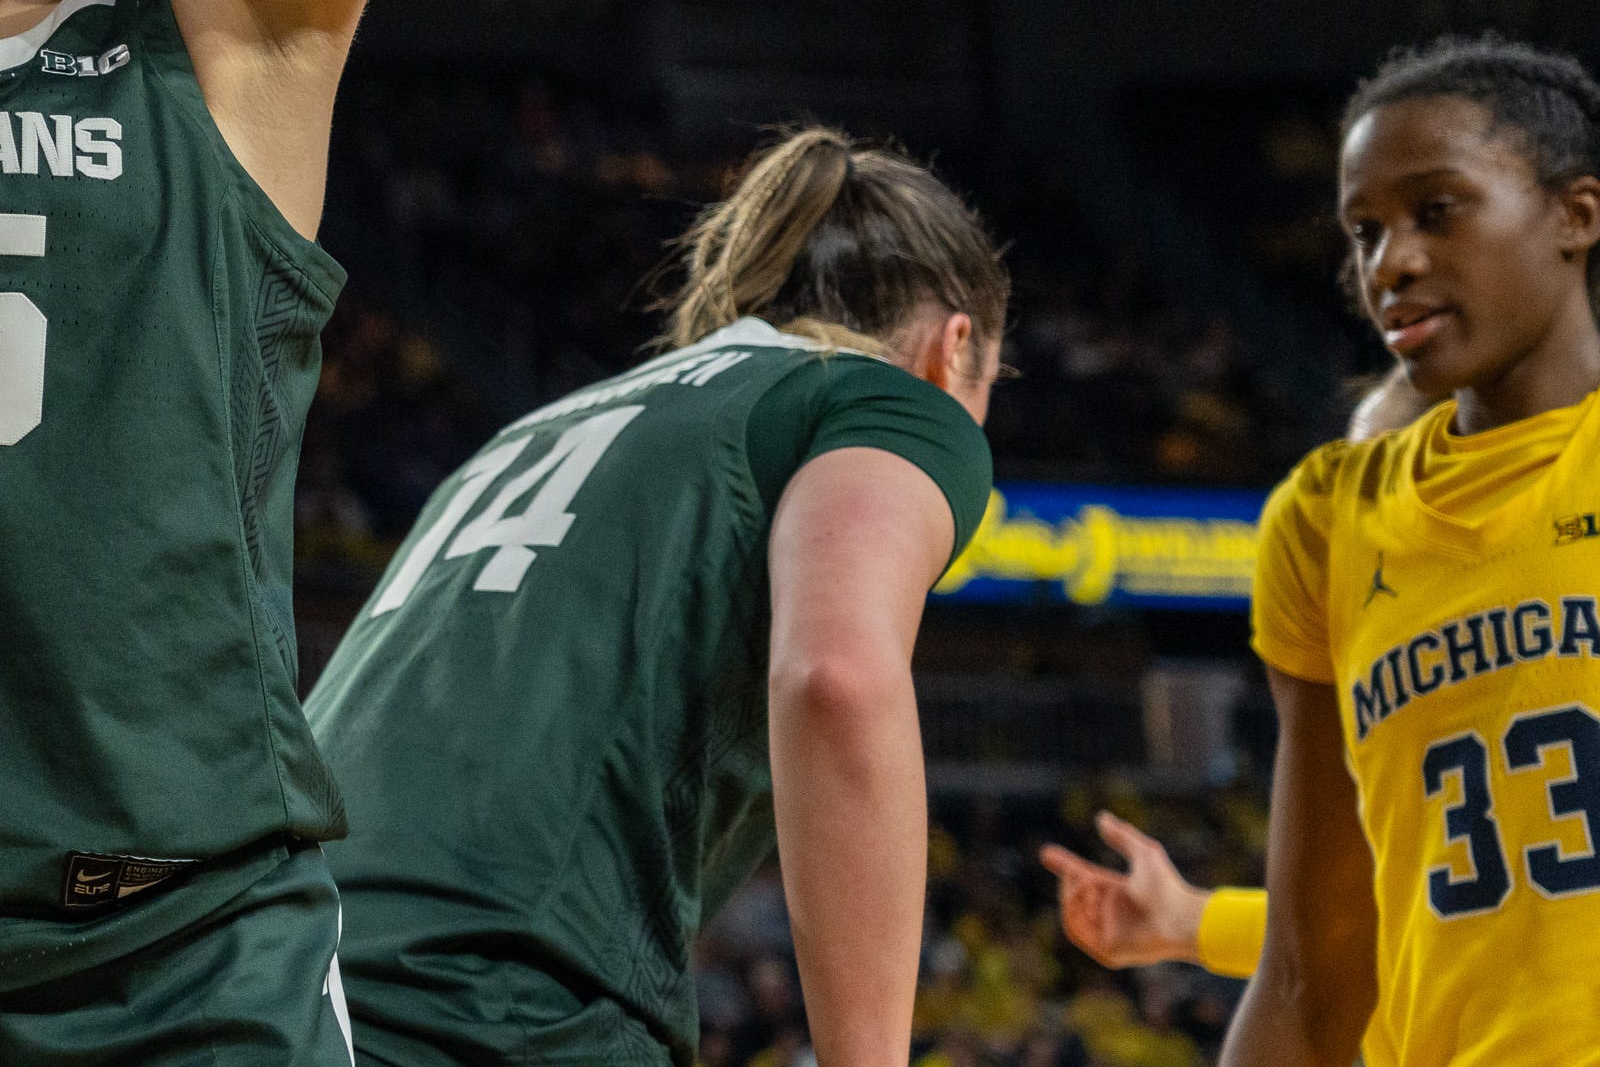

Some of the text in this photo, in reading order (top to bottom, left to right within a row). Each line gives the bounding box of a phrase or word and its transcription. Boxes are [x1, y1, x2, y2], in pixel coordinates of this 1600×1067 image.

[371, 404, 646, 617] 14
[1350, 595, 1600, 742] MICHIGA
[1422, 701, 1600, 920] 33
